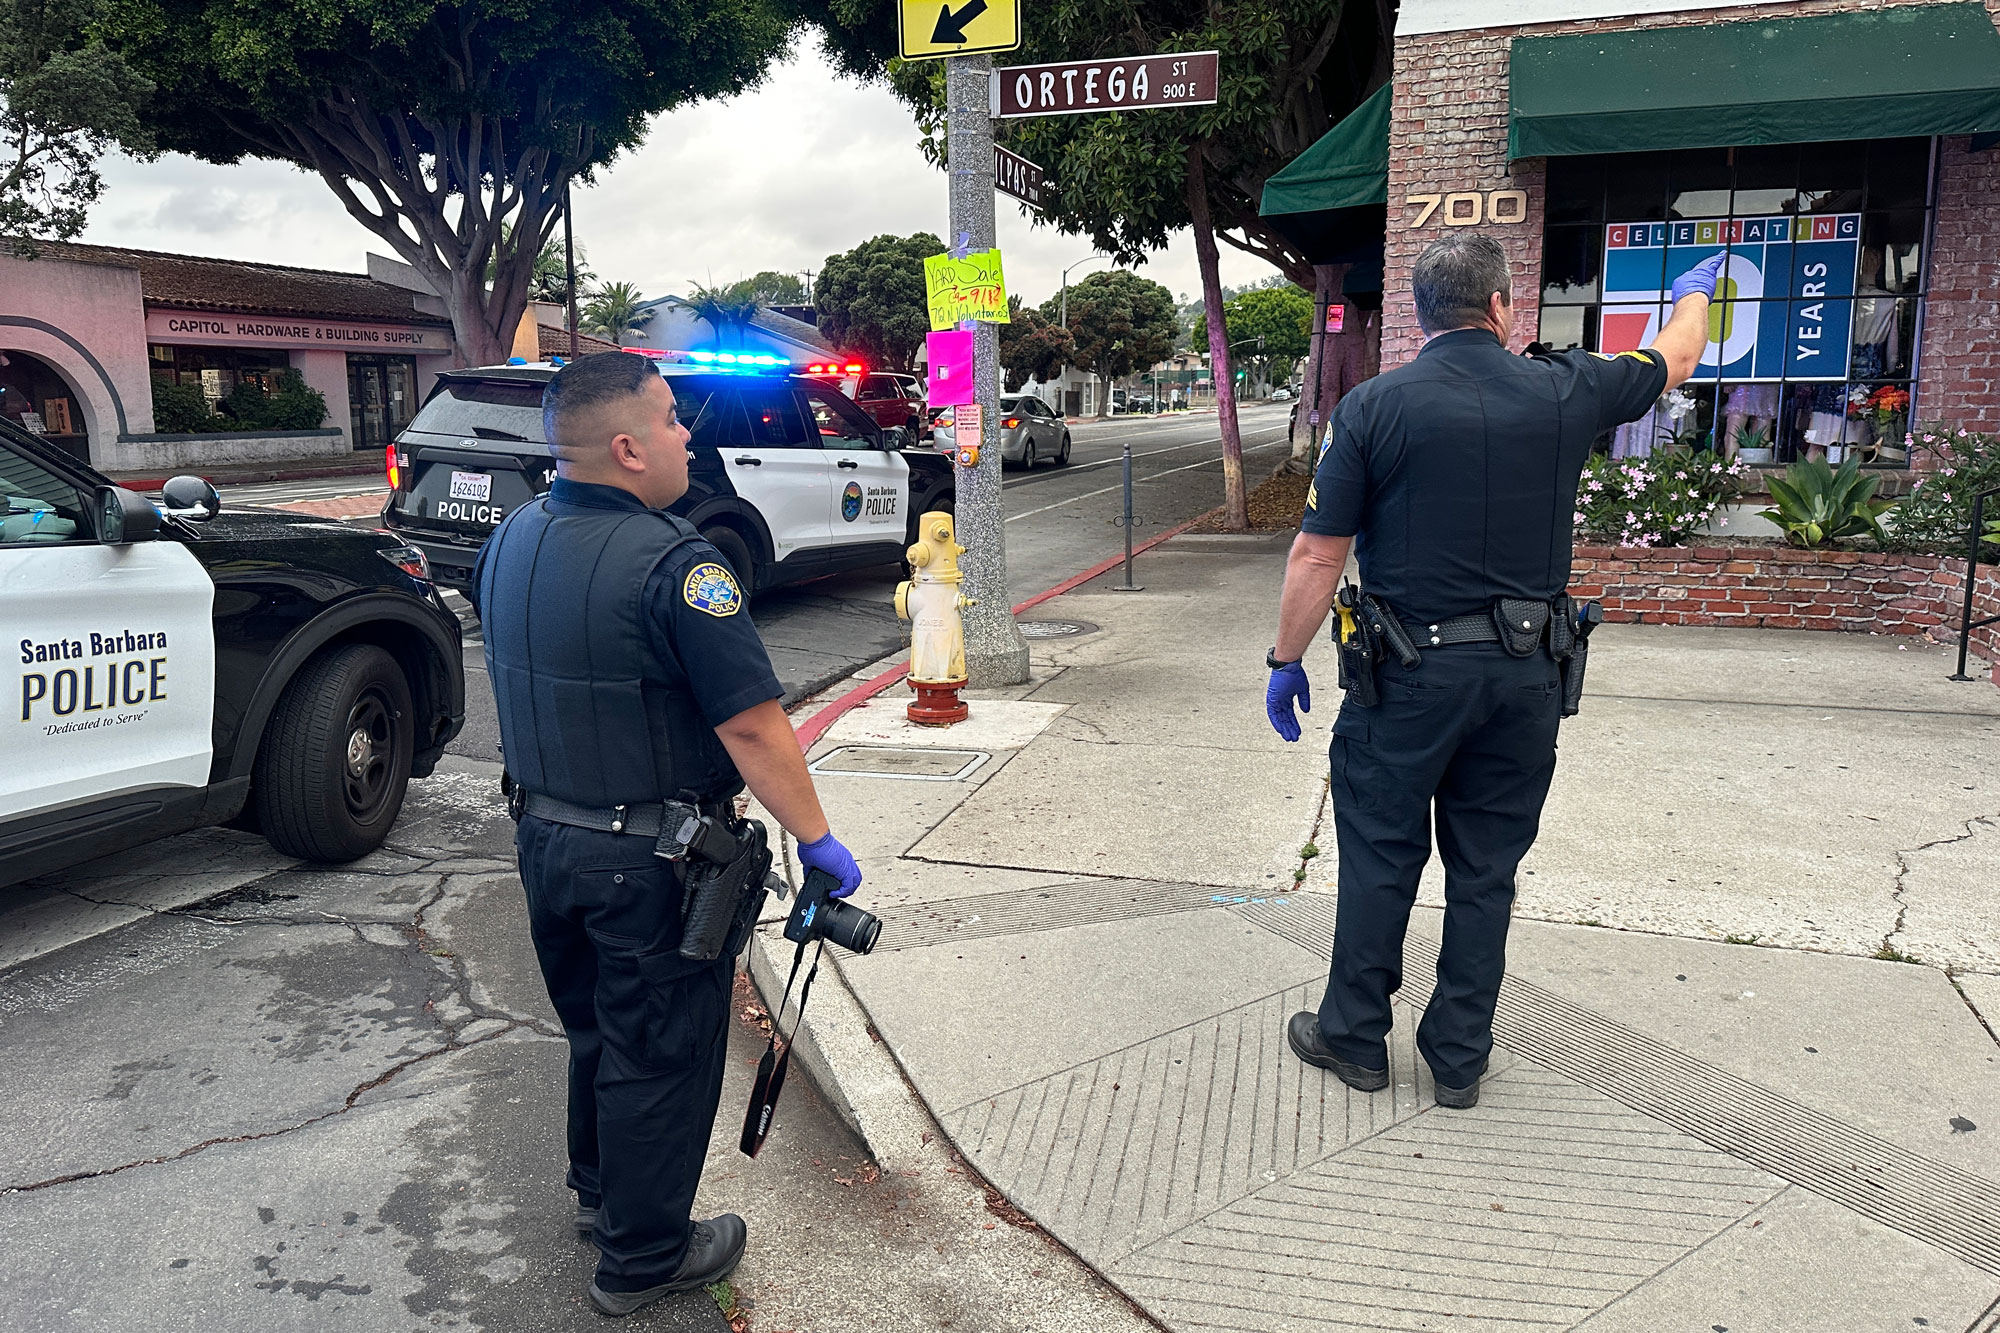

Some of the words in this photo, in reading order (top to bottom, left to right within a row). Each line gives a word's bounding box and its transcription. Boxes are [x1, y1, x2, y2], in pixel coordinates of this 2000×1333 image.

[1172, 61, 1188, 77] ST
[1015, 64, 1149, 109] ORTEGA
[1162, 83, 1186, 99] 900
[1188, 82, 1197, 98] E
[995, 151, 1026, 196] ILPAS
[1406, 189, 1528, 228] 700
[1612, 220, 1854, 243] CELEBRATING
[927, 262, 956, 292] YARD
[1796, 262, 1828, 361] YEARS
[169, 319, 230, 334] CAPITOL
[237, 323, 310, 338] HARDWARE
[315, 327, 323, 339] &
[326, 328, 379, 342] BUILDING
[384, 332, 424, 344] SUPPLY
[452, 481, 488, 498] 1626102
[867, 486, 880, 496] Santa
[881, 486, 897, 496] Barbara
[437, 501, 503, 525] POLICE
[865, 497, 897, 516] POLICE
[688, 573, 703, 603] SANTA
[708, 599, 737, 614] POLICE
[20, 638, 83, 664] Santa
[90, 629, 167, 656] Barbara
[20, 656, 168, 722] POLICE
[102, 717, 113, 727] to
[757, 1103, 772, 1136] Canon
